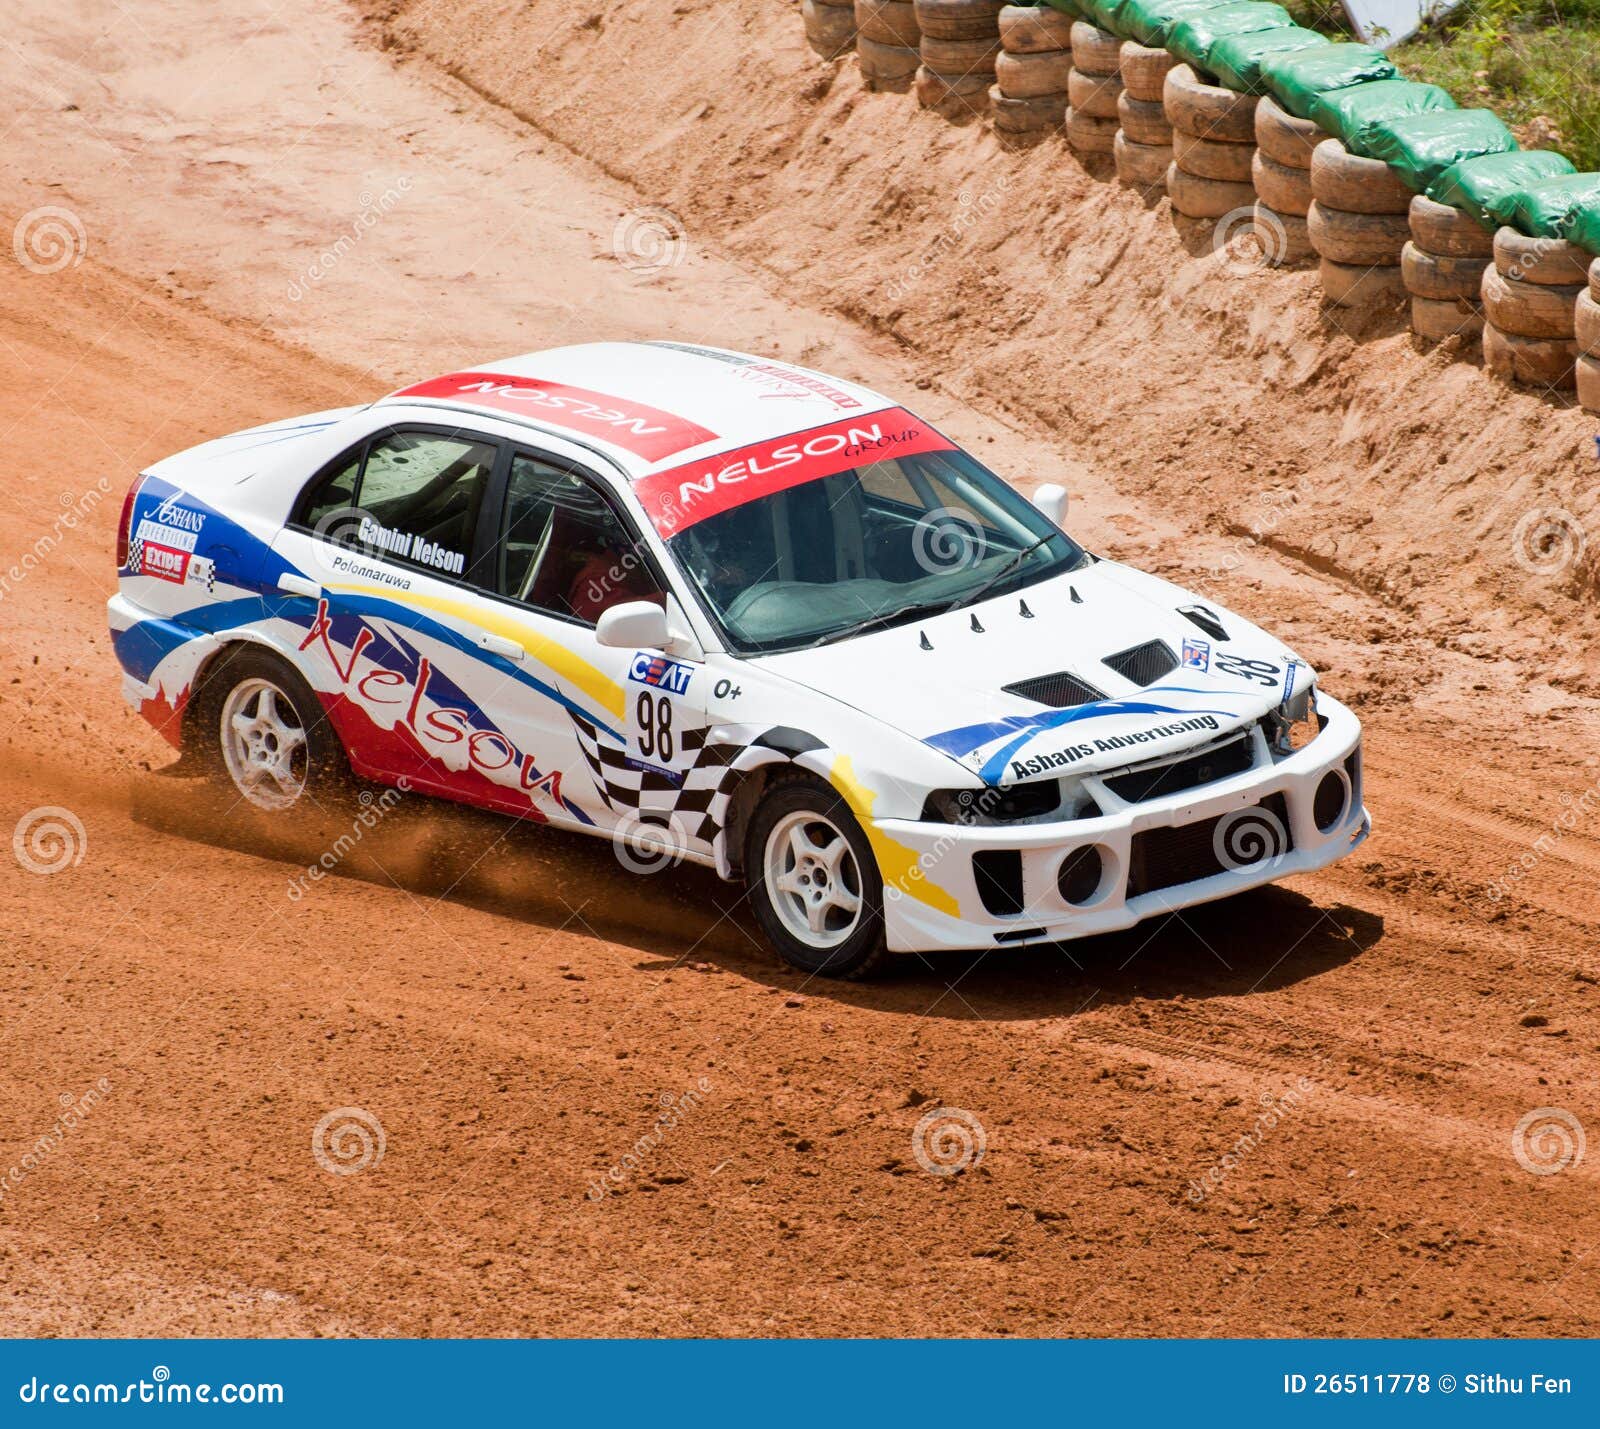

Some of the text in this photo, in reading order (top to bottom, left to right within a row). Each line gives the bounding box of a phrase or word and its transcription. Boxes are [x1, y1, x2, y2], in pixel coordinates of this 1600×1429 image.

[458, 381, 667, 435] NELSON
[679, 424, 920, 503] NELSON GROUP
[145, 546, 183, 573] EXIDE
[332, 556, 411, 590] Polonnaruwa
[358, 517, 465, 574] Gamini Nelson
[630, 655, 694, 692] CEAT
[298, 599, 568, 811] Nelson
[637, 690, 673, 763] 98
[1010, 714, 1219, 780] Ashans Advertising
